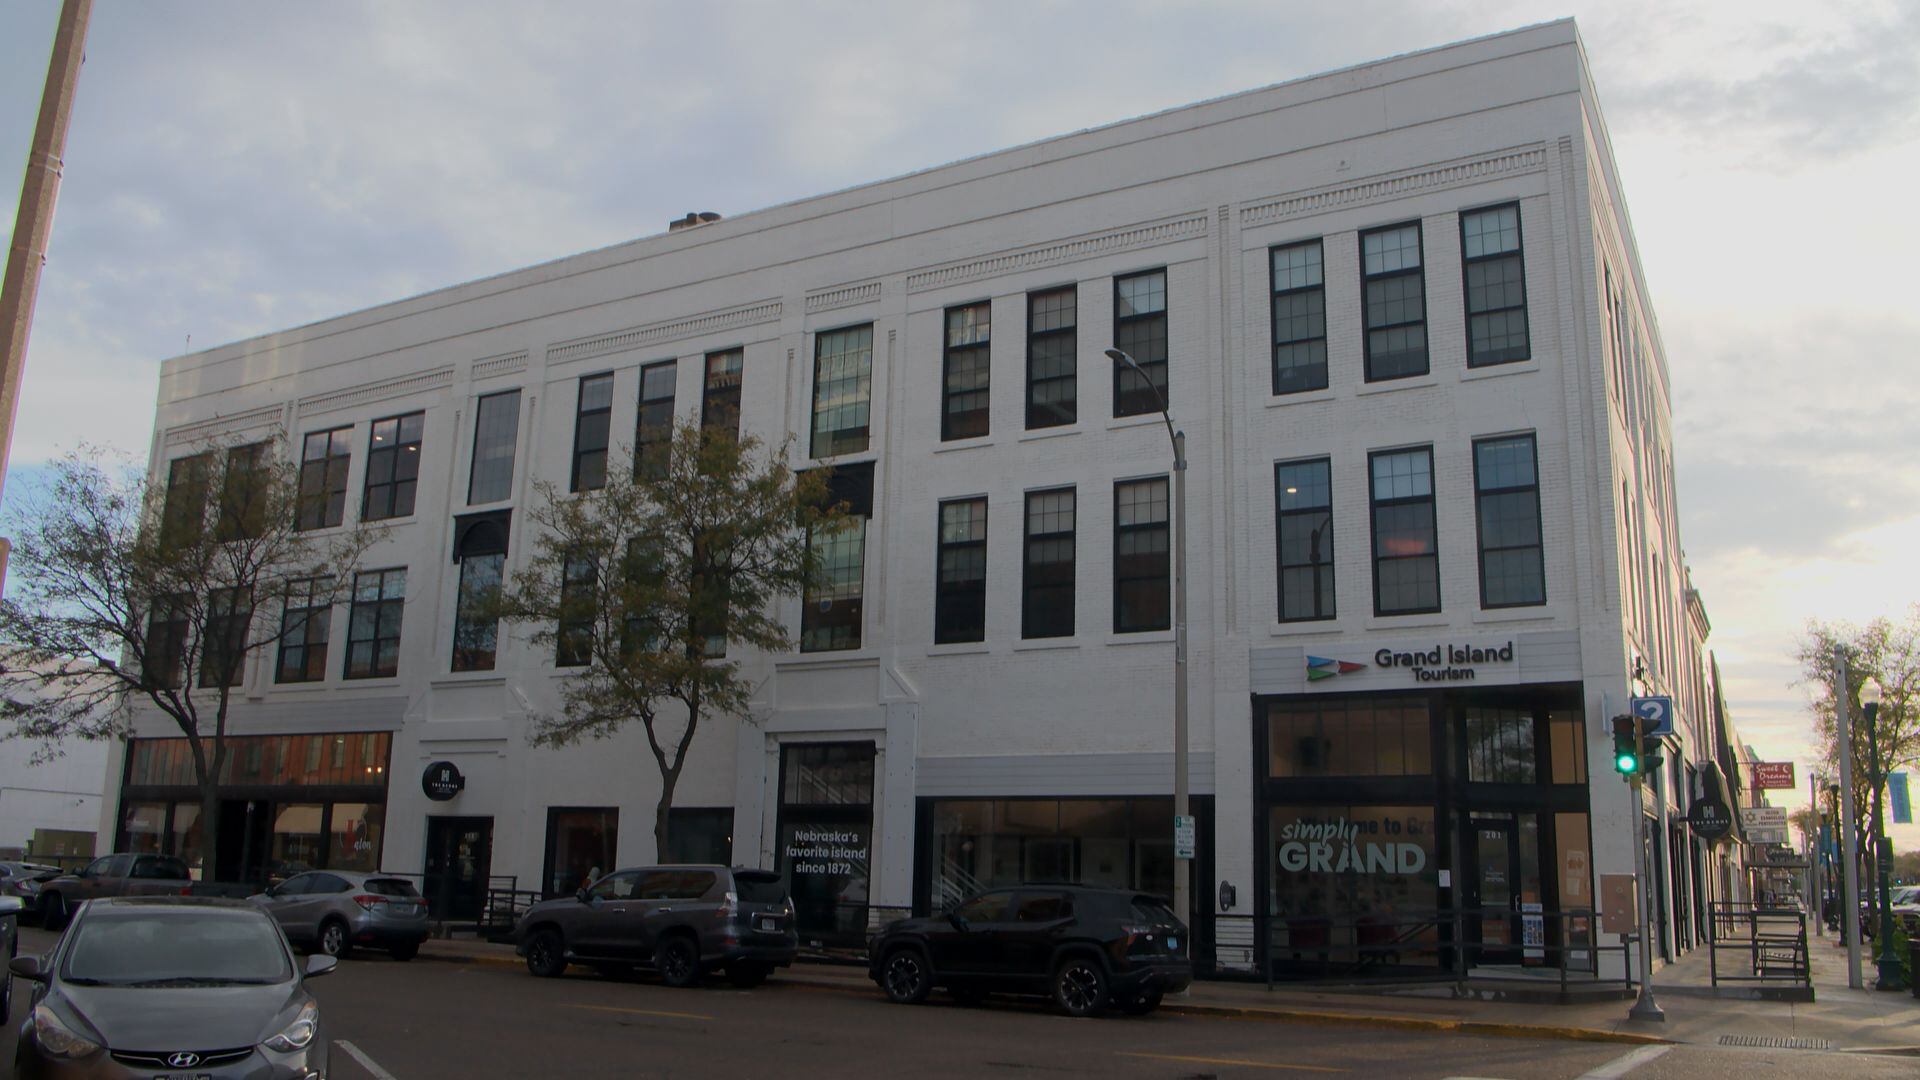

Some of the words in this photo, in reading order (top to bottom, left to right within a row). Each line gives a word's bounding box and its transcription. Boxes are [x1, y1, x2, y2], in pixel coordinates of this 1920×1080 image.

[1375, 645, 1441, 667] Grand
[1449, 641, 1513, 664] Island
[1412, 666, 1474, 681] Tourism
[795, 831, 858, 842] Nebraska's
[1281, 816, 1359, 847] simply
[1486, 831, 1501, 839] 201
[786, 845, 829, 857] favorite
[831, 845, 866, 858] island
[1279, 842, 1426, 874] GRAND
[796, 861, 825, 873] since
[828, 863, 851, 874] 1872
